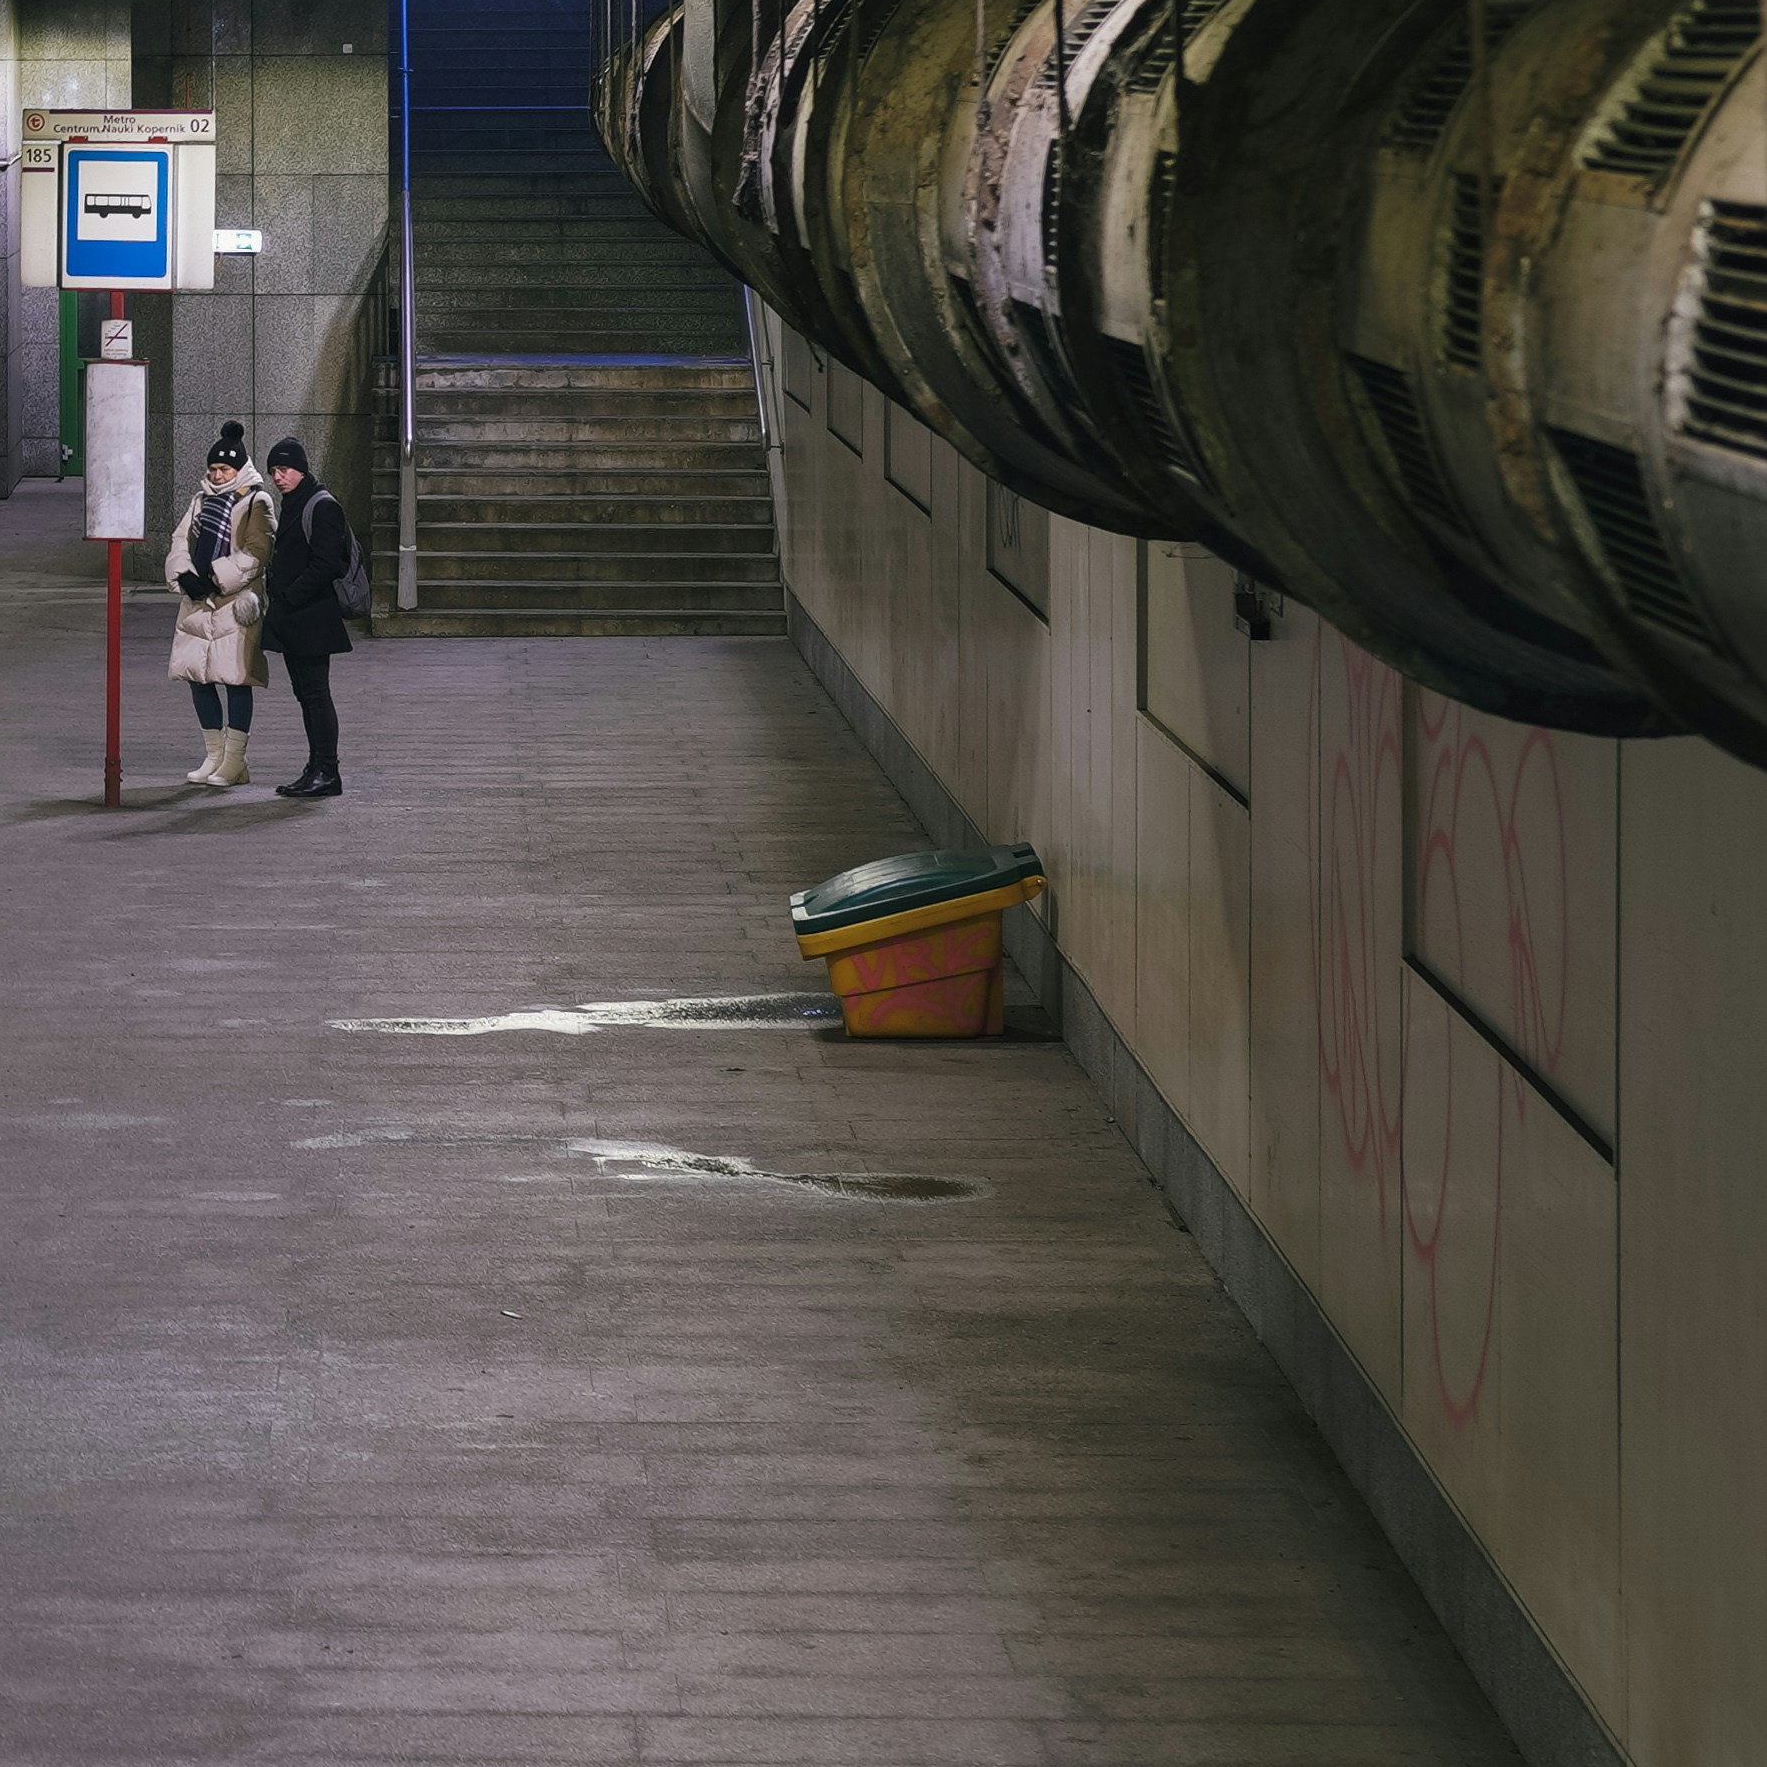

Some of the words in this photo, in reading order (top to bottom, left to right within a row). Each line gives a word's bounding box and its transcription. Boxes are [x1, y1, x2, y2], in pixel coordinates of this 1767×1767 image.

[103, 115, 136, 124] Metro
[189, 118, 210, 133] 02
[53, 124, 101, 133] Centrum
[102, 124, 134, 133] Nauki
[137, 124, 186, 135] Kopernik
[26, 148, 52, 163] 185
